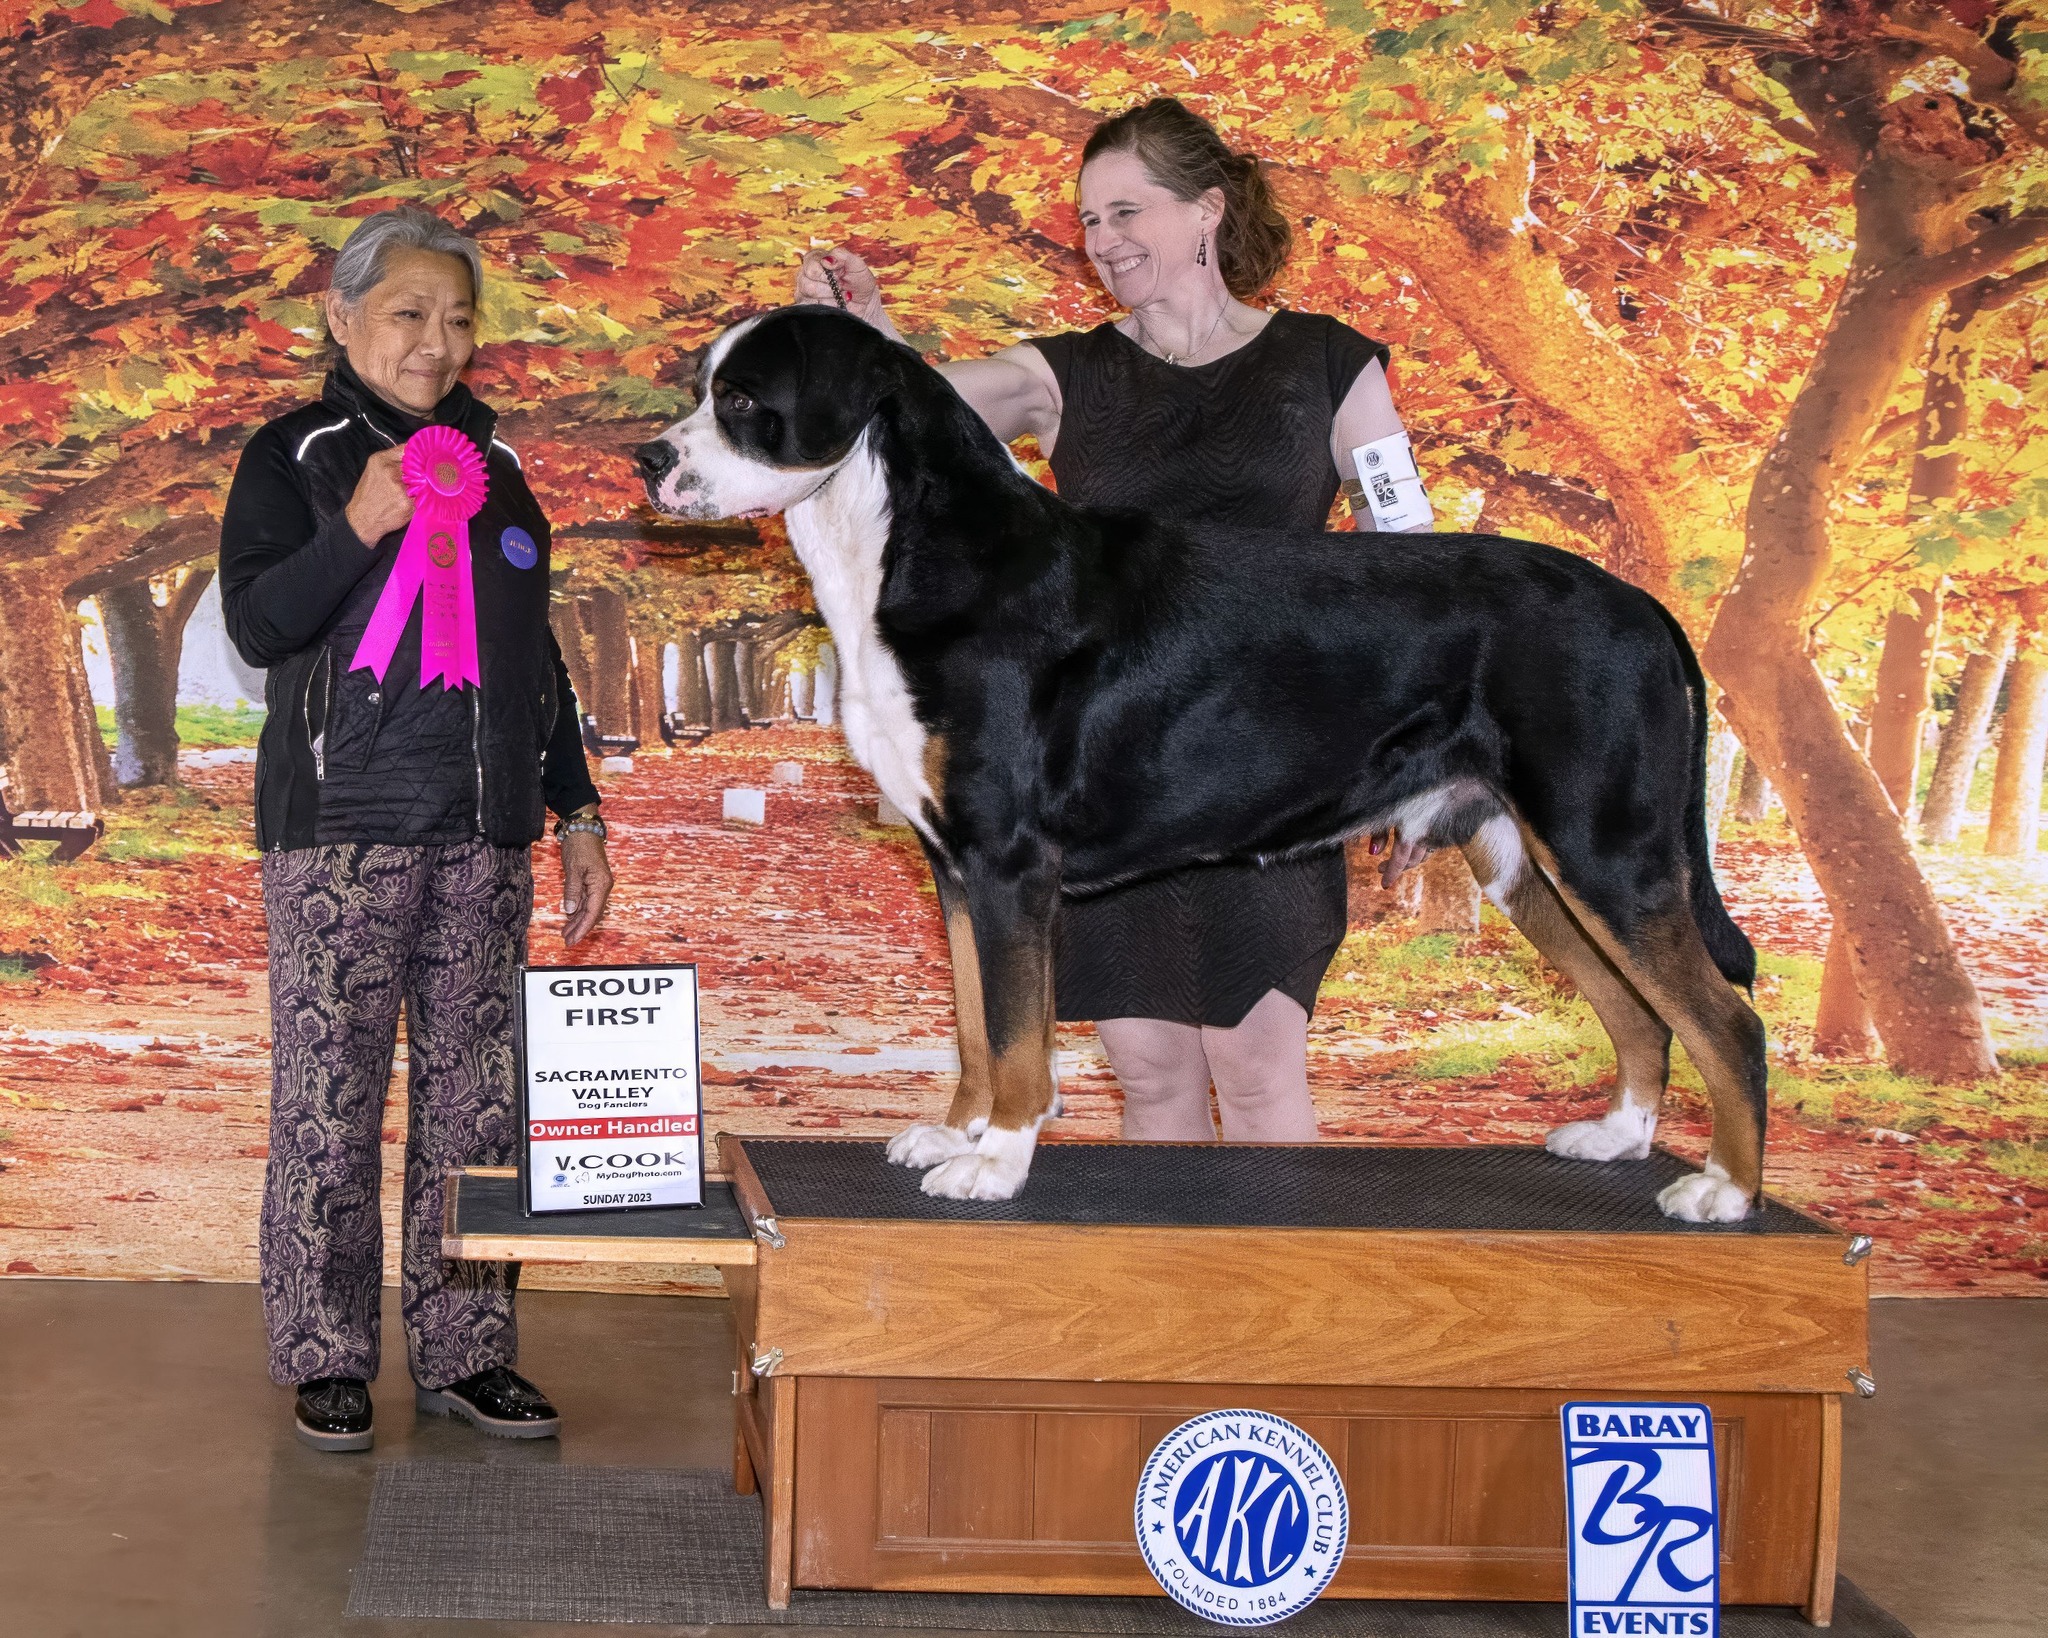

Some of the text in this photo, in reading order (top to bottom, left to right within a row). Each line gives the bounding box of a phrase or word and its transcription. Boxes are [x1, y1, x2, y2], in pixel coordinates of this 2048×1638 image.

[549, 977, 674, 997] GROUP
[566, 1006, 661, 1027] FIRST
[535, 1067, 688, 1083] SACRAMENTO
[571, 1086, 654, 1100] VALLEY
[578, 1101, 648, 1110] Dog Fanciers
[529, 1117, 696, 1137] Owner Handled
[596, 1169, 682, 1181] MyDogPhoto.com
[583, 1193, 652, 1205] SUNDAY 2023
[1576, 1414, 1701, 1438] BARAY
[1151, 1423, 1333, 1555] AMERICAN KENNEL CLUB
[1176, 1456, 1300, 1584] AKC
[1163, 1558, 1287, 1611] FOUNDED 1884
[1583, 1611, 1709, 1635] EVENTS
